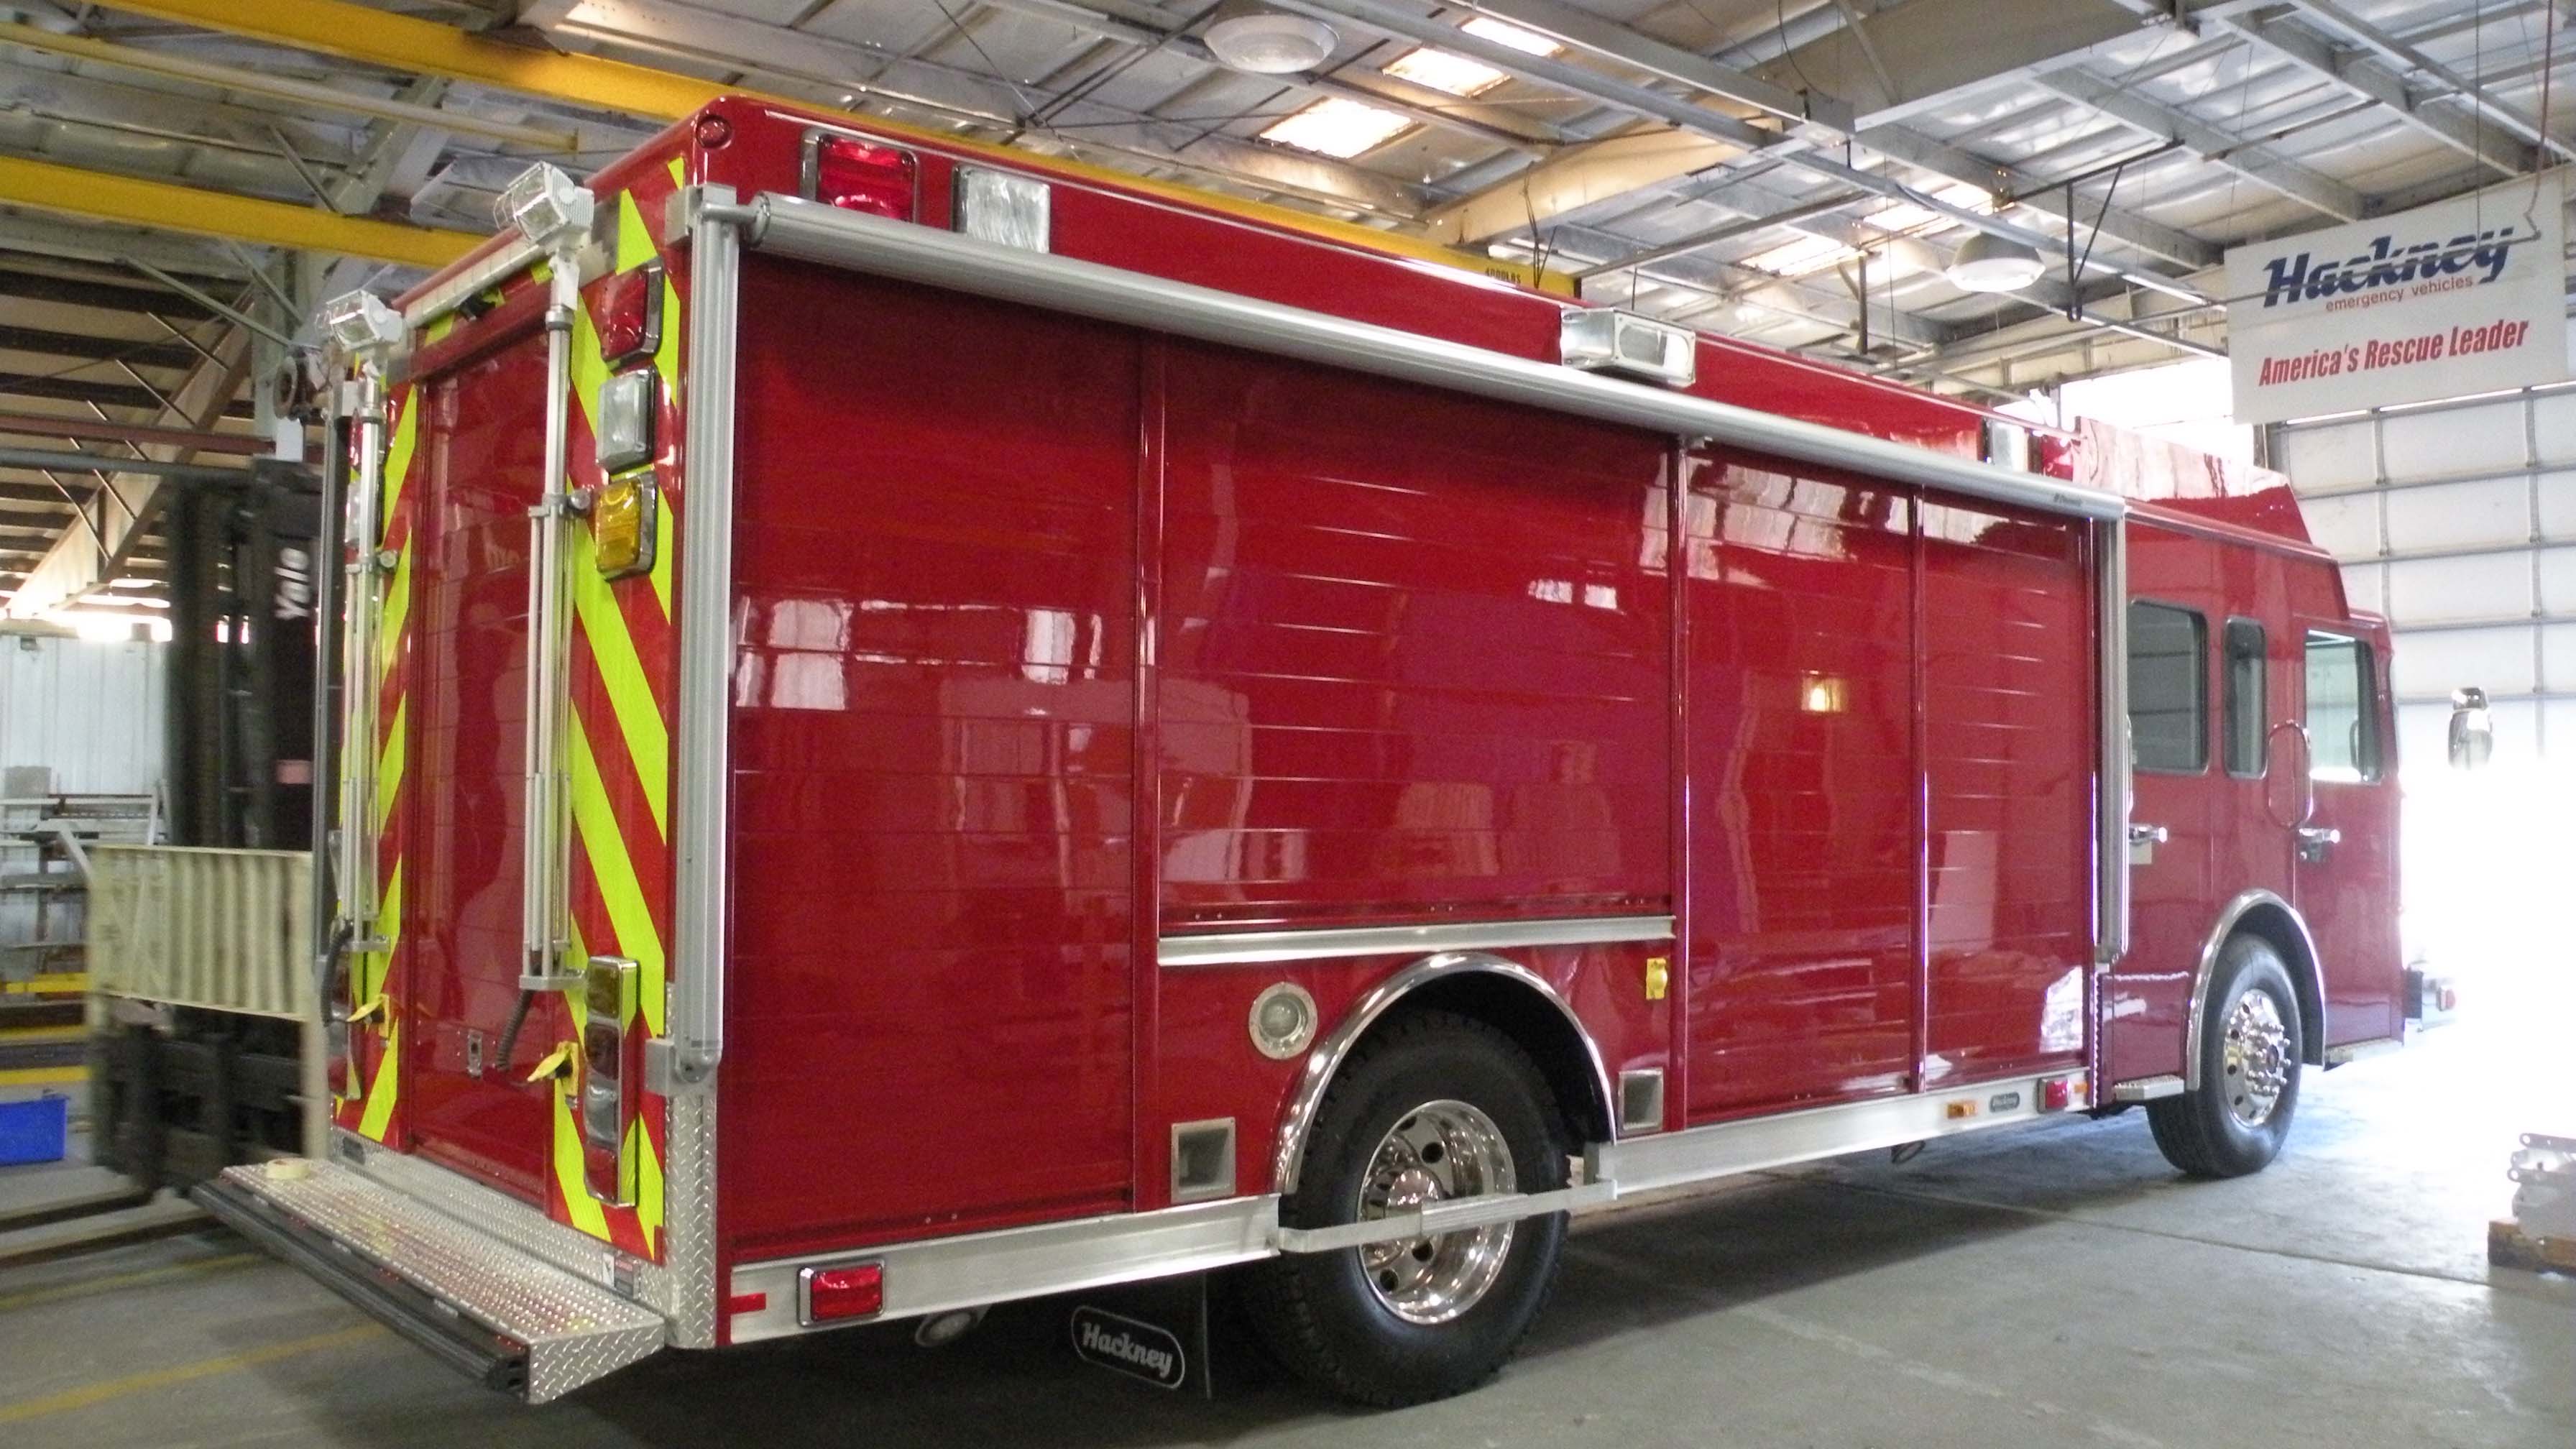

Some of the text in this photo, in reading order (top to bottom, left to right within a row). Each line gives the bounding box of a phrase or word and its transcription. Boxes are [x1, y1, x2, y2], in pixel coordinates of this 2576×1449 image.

[2263, 226, 2514, 308] Hackney
[2326, 276, 2473, 311] emergency vehicles
[2258, 318, 2529, 387] America's Rescue Leader
[1082, 1322, 1173, 1379] Hackney
